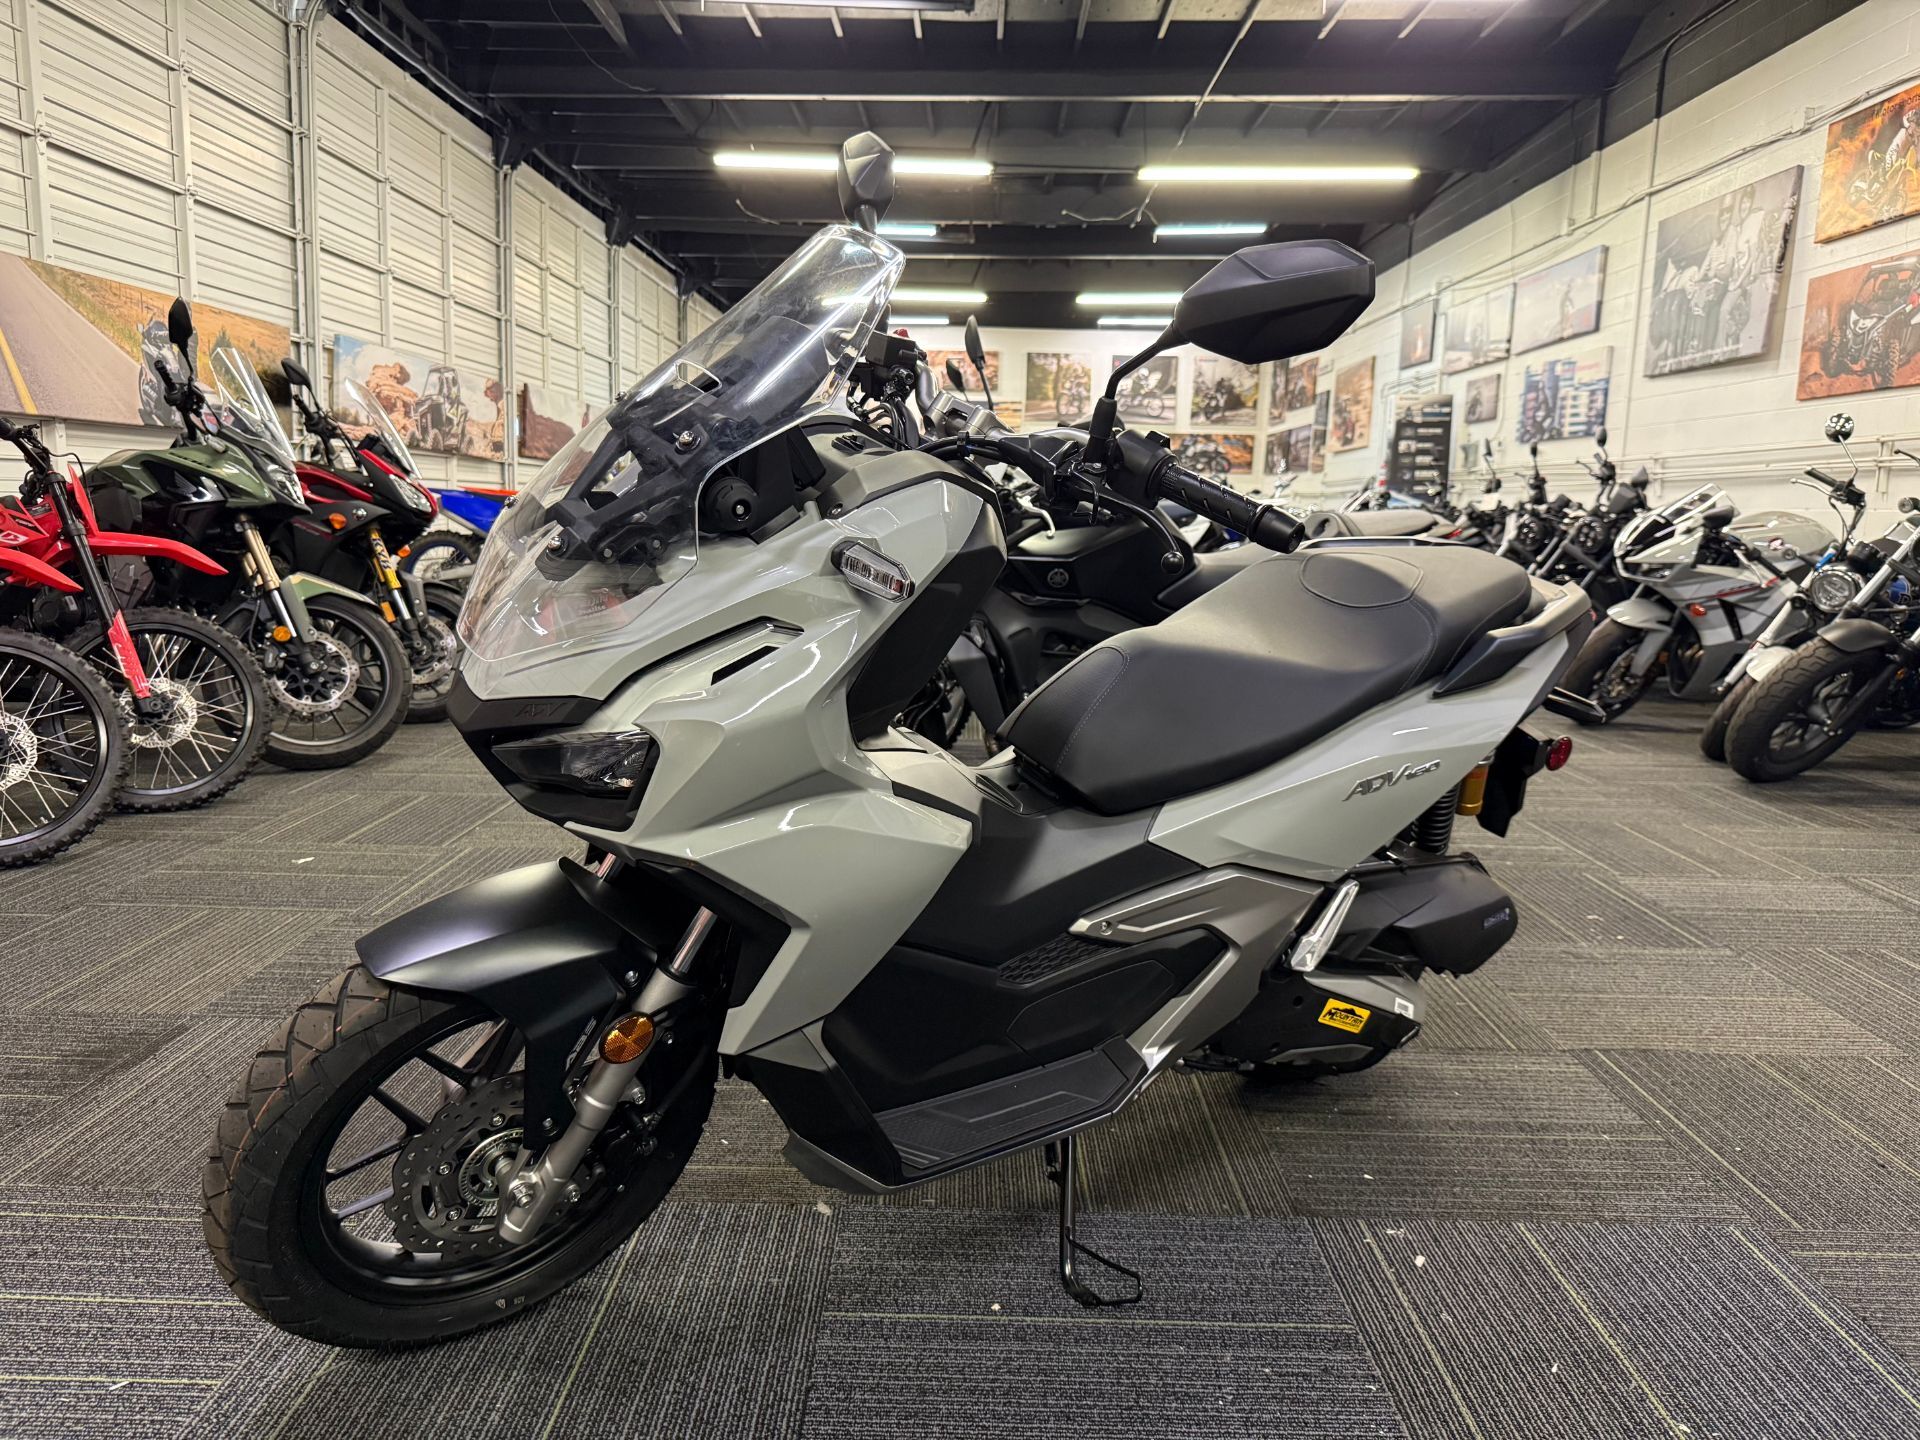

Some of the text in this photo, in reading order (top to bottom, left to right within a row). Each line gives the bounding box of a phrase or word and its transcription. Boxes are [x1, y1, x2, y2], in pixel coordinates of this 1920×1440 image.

[371, 538, 392, 569] KYB
[514, 702, 568, 718] ADV
[565, 1016, 597, 1071] ABS
